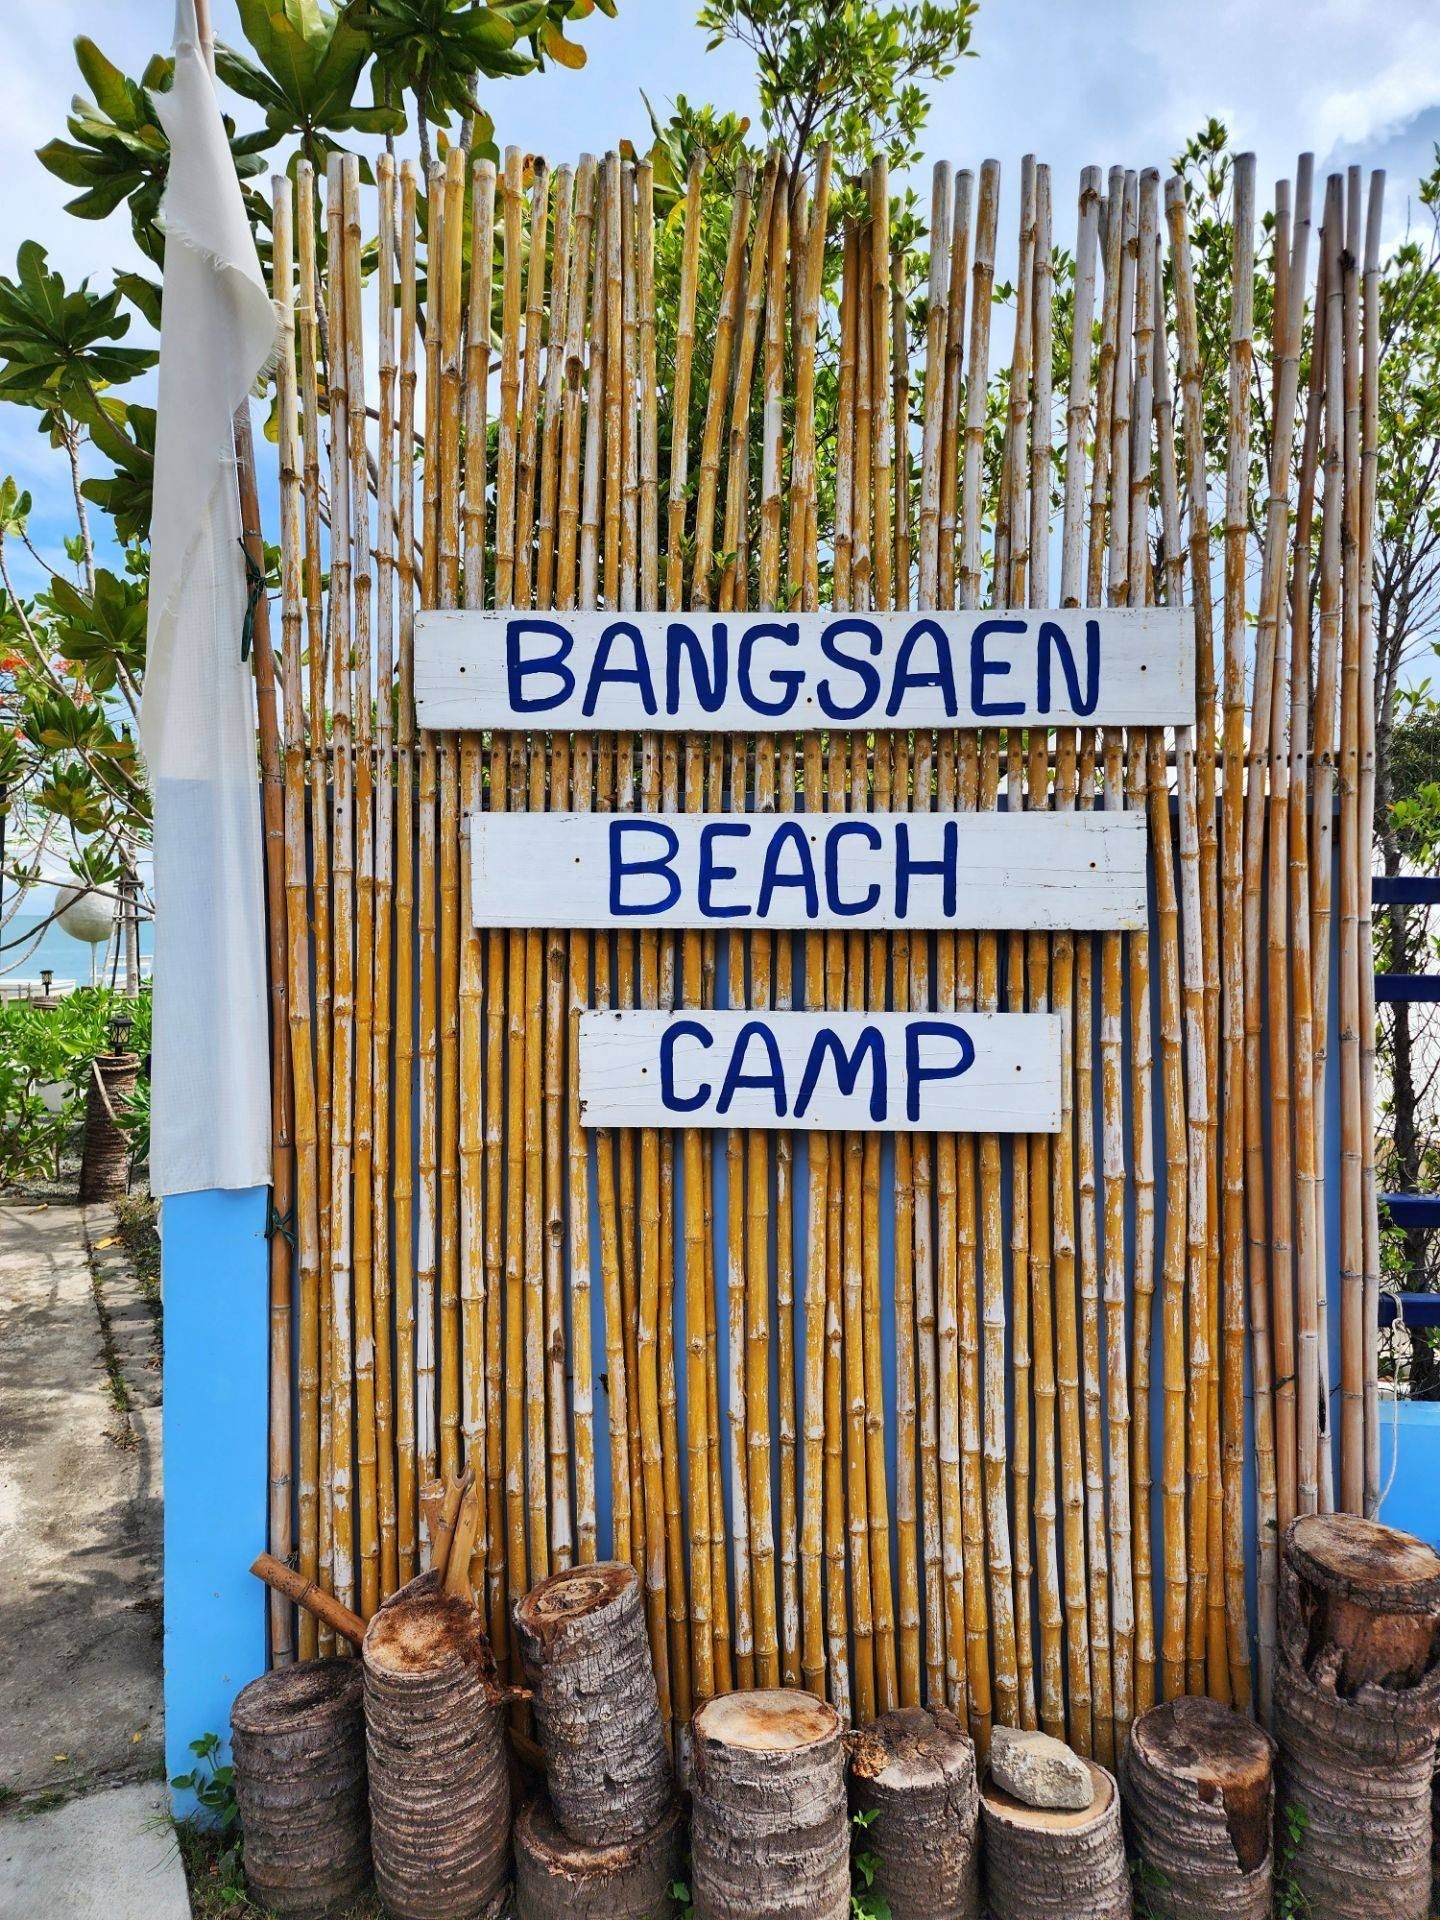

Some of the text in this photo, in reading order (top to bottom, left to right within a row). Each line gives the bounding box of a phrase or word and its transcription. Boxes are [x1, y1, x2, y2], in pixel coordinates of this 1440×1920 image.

[506, 618, 1101, 721] BANGSAEN
[608, 819, 958, 919] BEACH
[659, 1020, 976, 1123] CAMP
